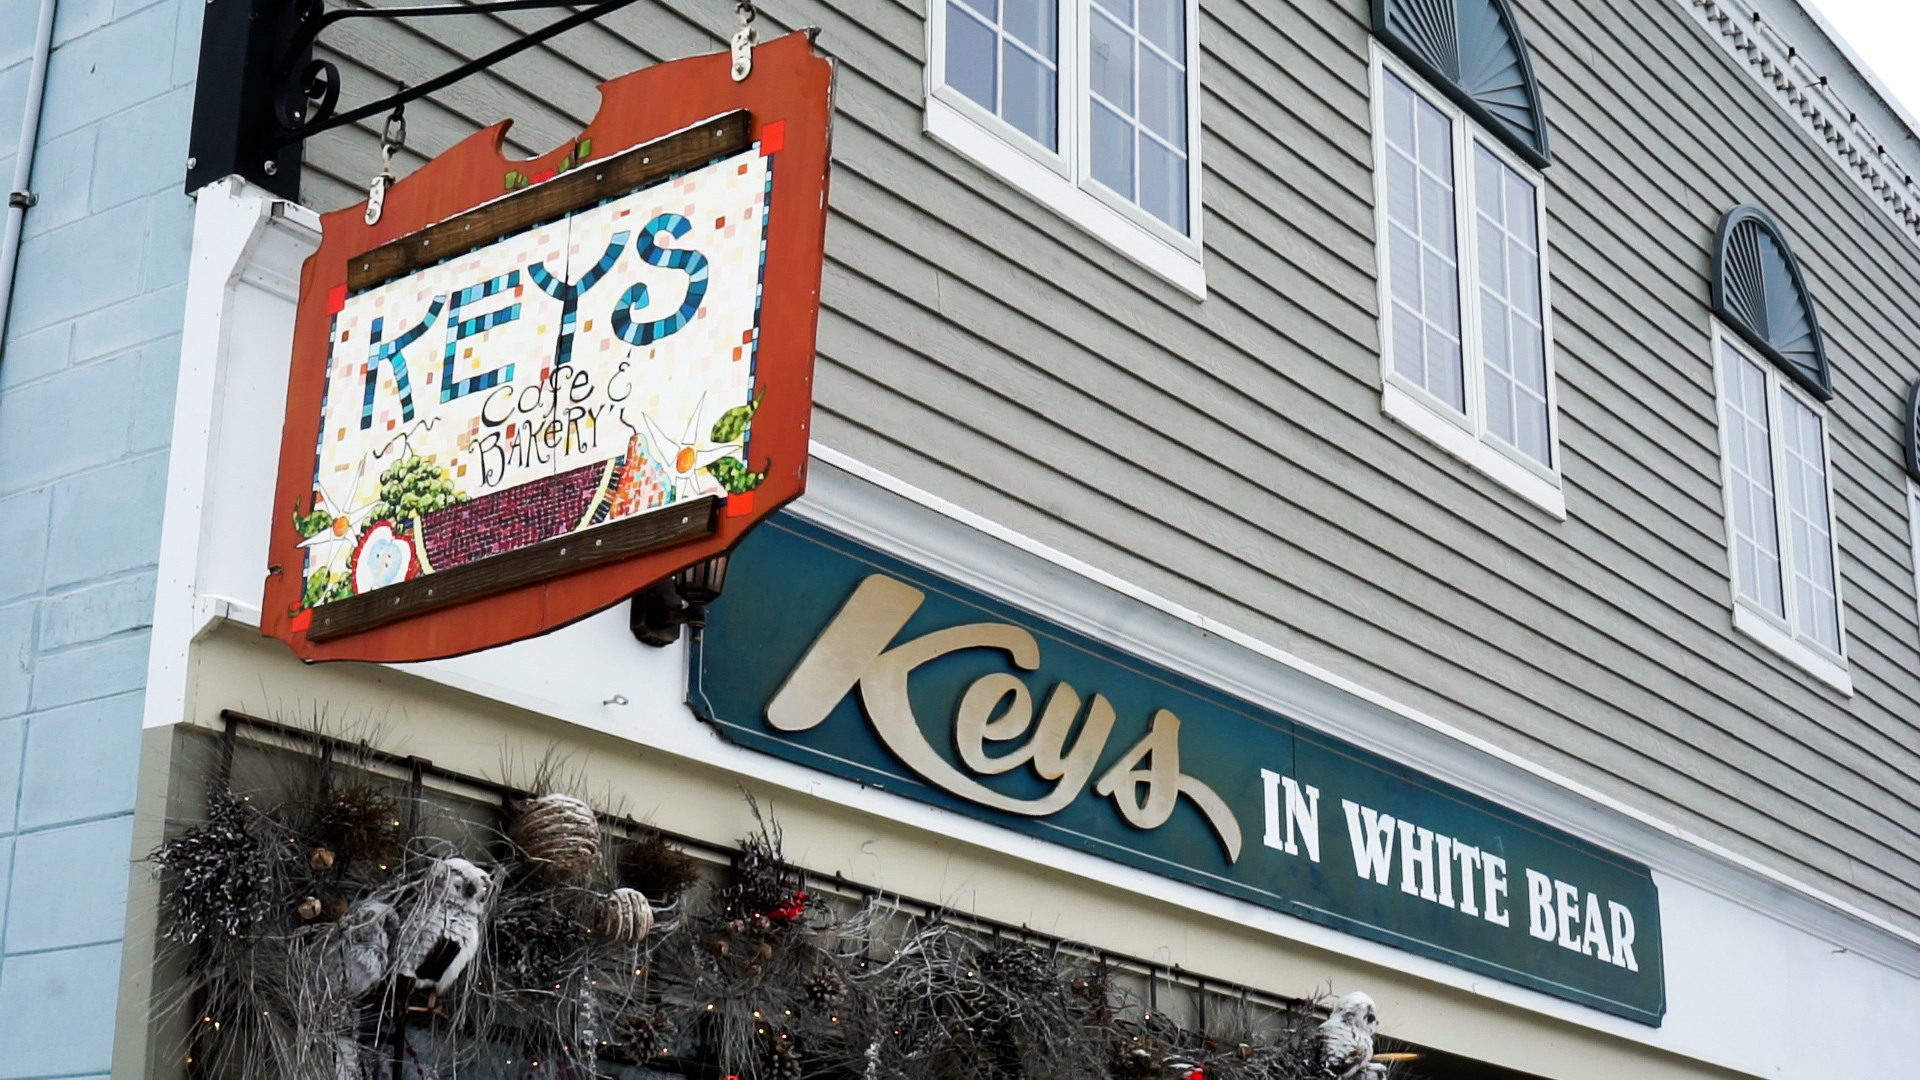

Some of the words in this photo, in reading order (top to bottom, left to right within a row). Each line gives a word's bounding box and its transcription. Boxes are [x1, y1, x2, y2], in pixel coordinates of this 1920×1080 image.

[361, 213, 709, 430] KEYS
[763, 574, 1242, 865] Keys
[1260, 768, 1321, 863] IN
[1341, 799, 1510, 927] WHITE
[1525, 868, 1639, 972] BEAR
